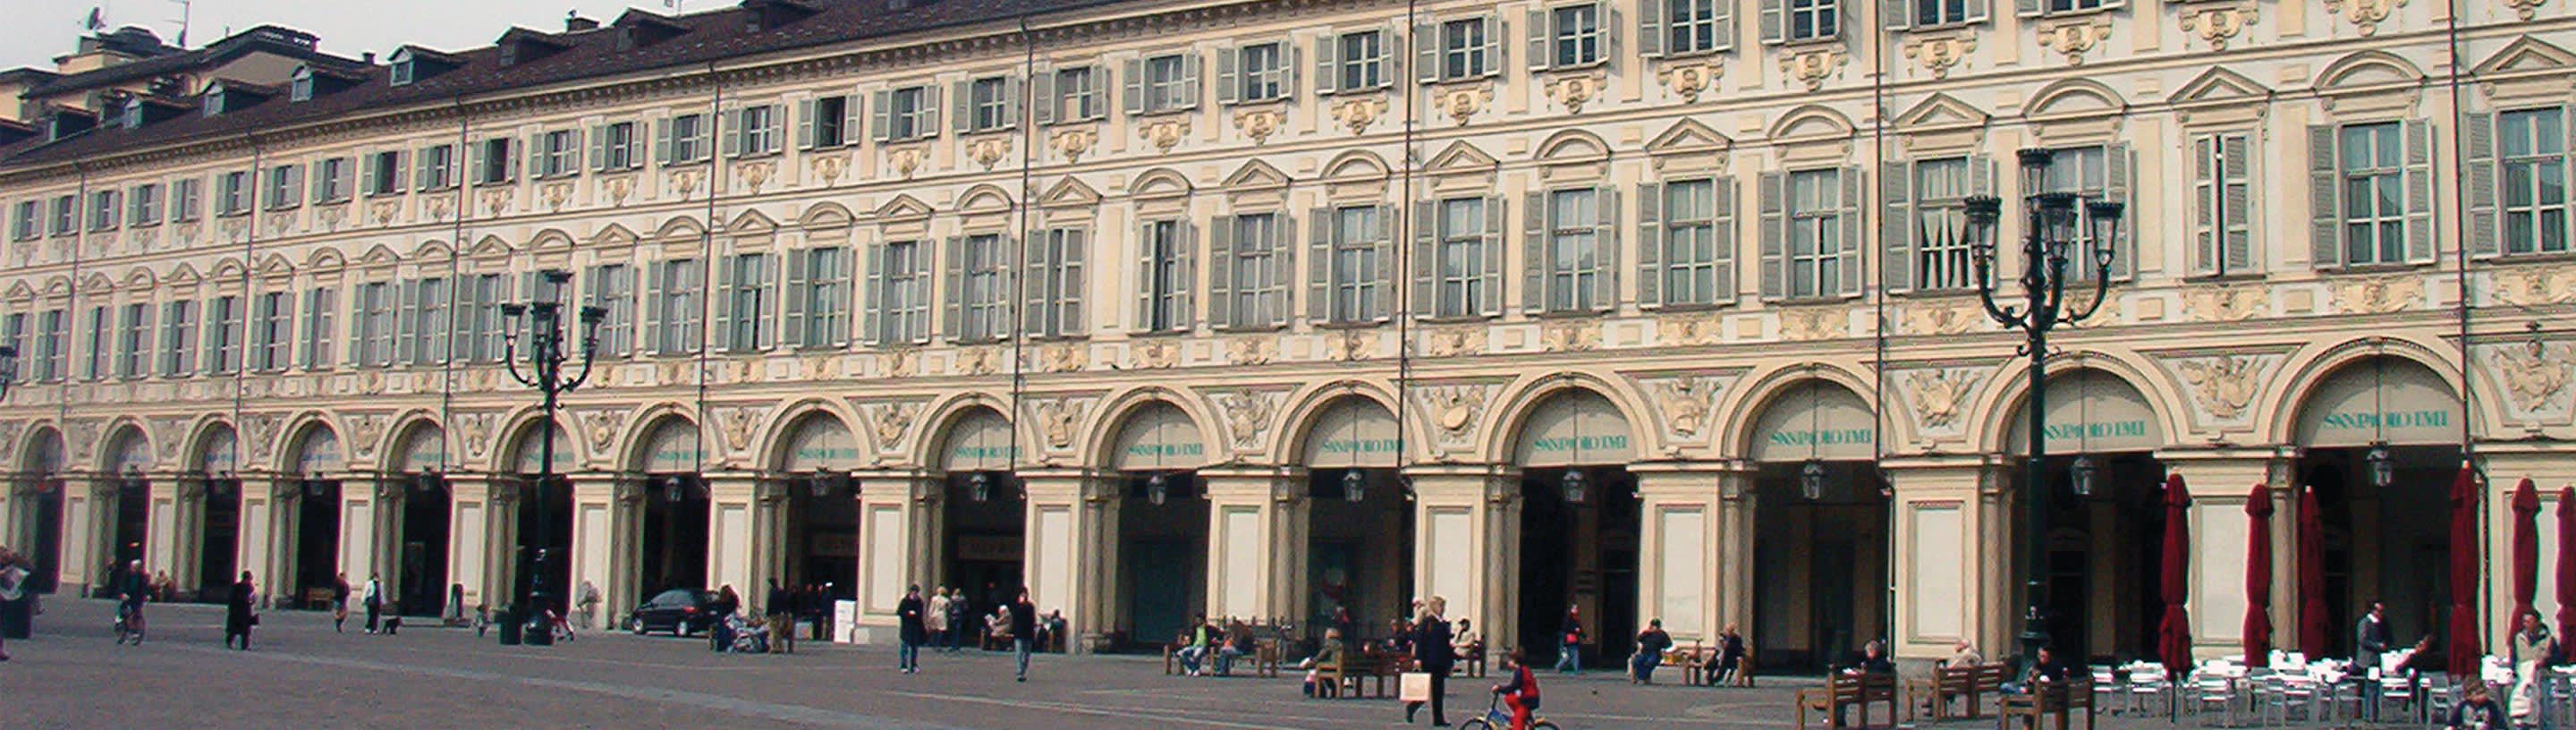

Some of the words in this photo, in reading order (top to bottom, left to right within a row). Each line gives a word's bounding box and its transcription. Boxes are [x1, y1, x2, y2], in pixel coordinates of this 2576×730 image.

[2114, 420, 2146, 437] IMI
[2323, 412, 2412, 429] SANPAOLO
[2414, 411, 2448, 427] IMI
[1845, 429, 1872, 444] IMI
